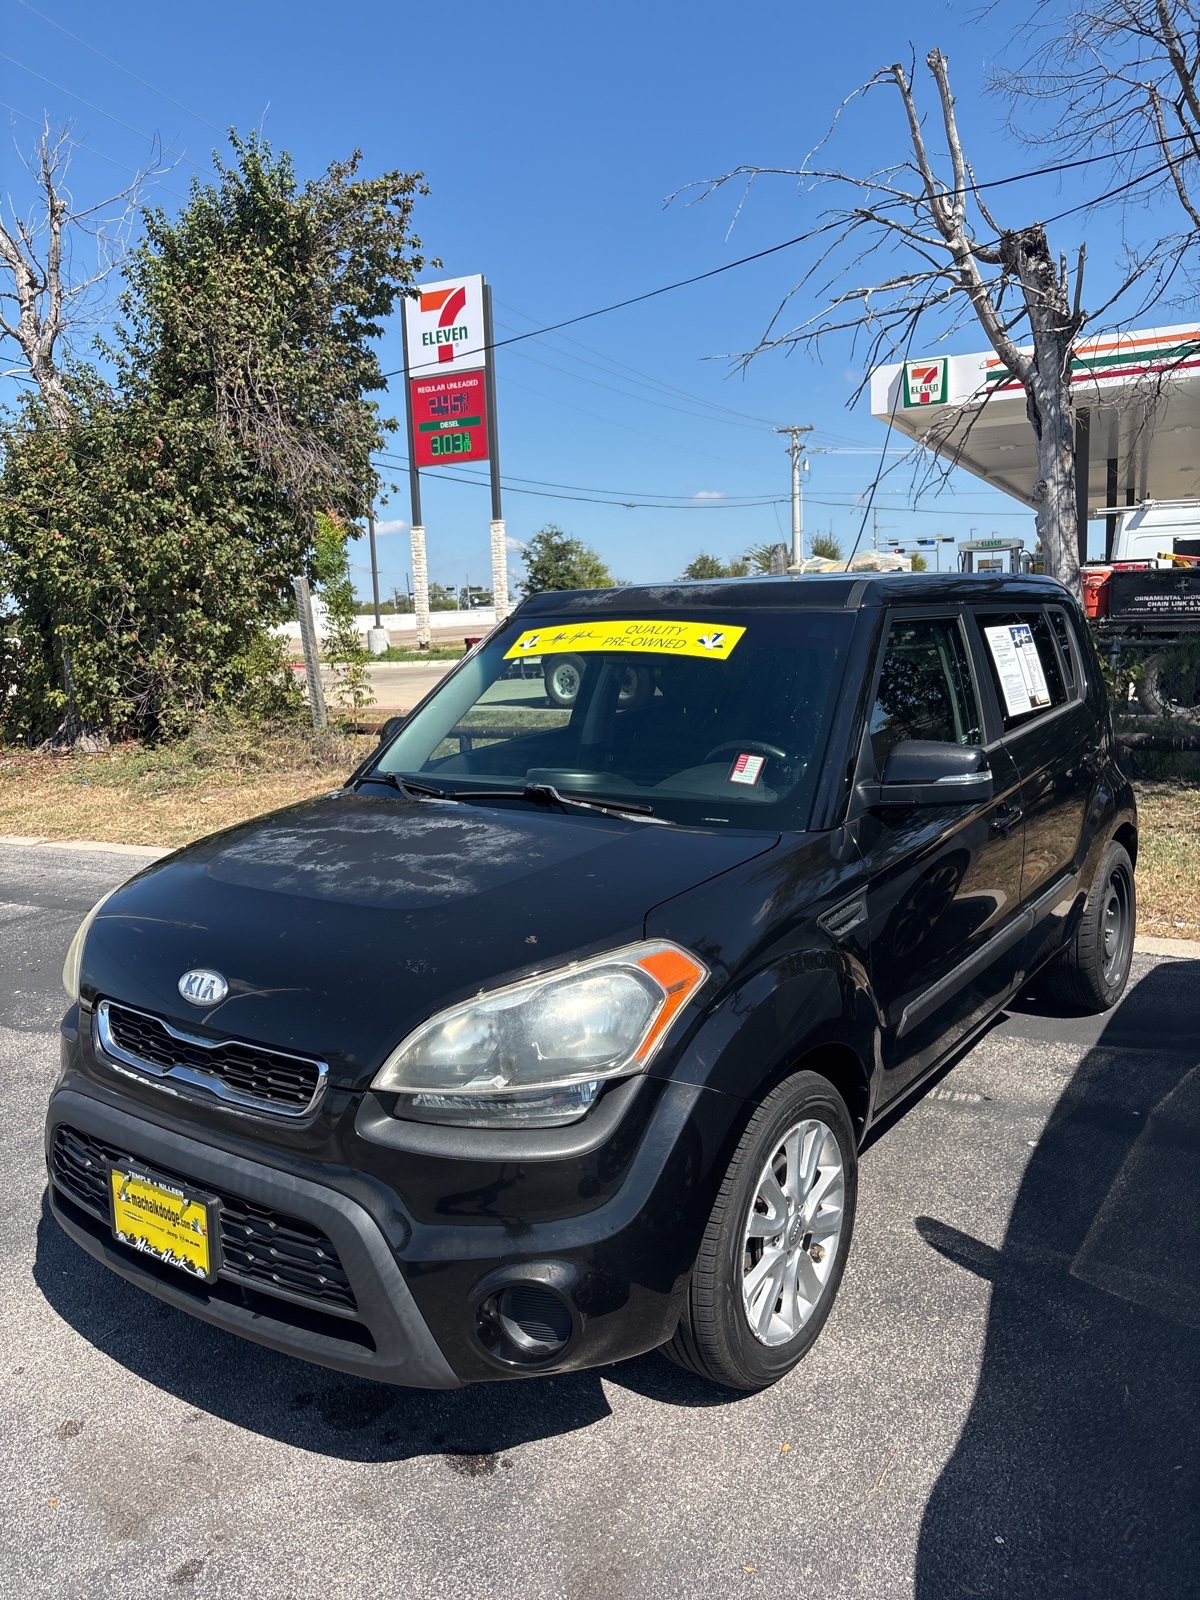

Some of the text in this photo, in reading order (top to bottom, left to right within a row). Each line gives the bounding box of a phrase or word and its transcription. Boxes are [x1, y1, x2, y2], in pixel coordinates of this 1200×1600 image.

[420, 286, 466, 364] 7
[422, 325, 468, 346] ELEVEN
[417, 379, 479, 394] REGULAR UNLEADED
[911, 366, 938, 403] 7
[911, 383, 939, 394] ELEVEN
[440, 420, 459, 429] DIESEL
[430, 433, 463, 456] 3.03
[625, 625, 688, 636] QUALITY
[601, 636, 687, 649] PRE-OWNED
[183, 974, 216, 1000] KIA
[128, 1170, 184, 1197] TEMPLE KILLEEN
[134, 1237, 189, 1268] Mac Haik
